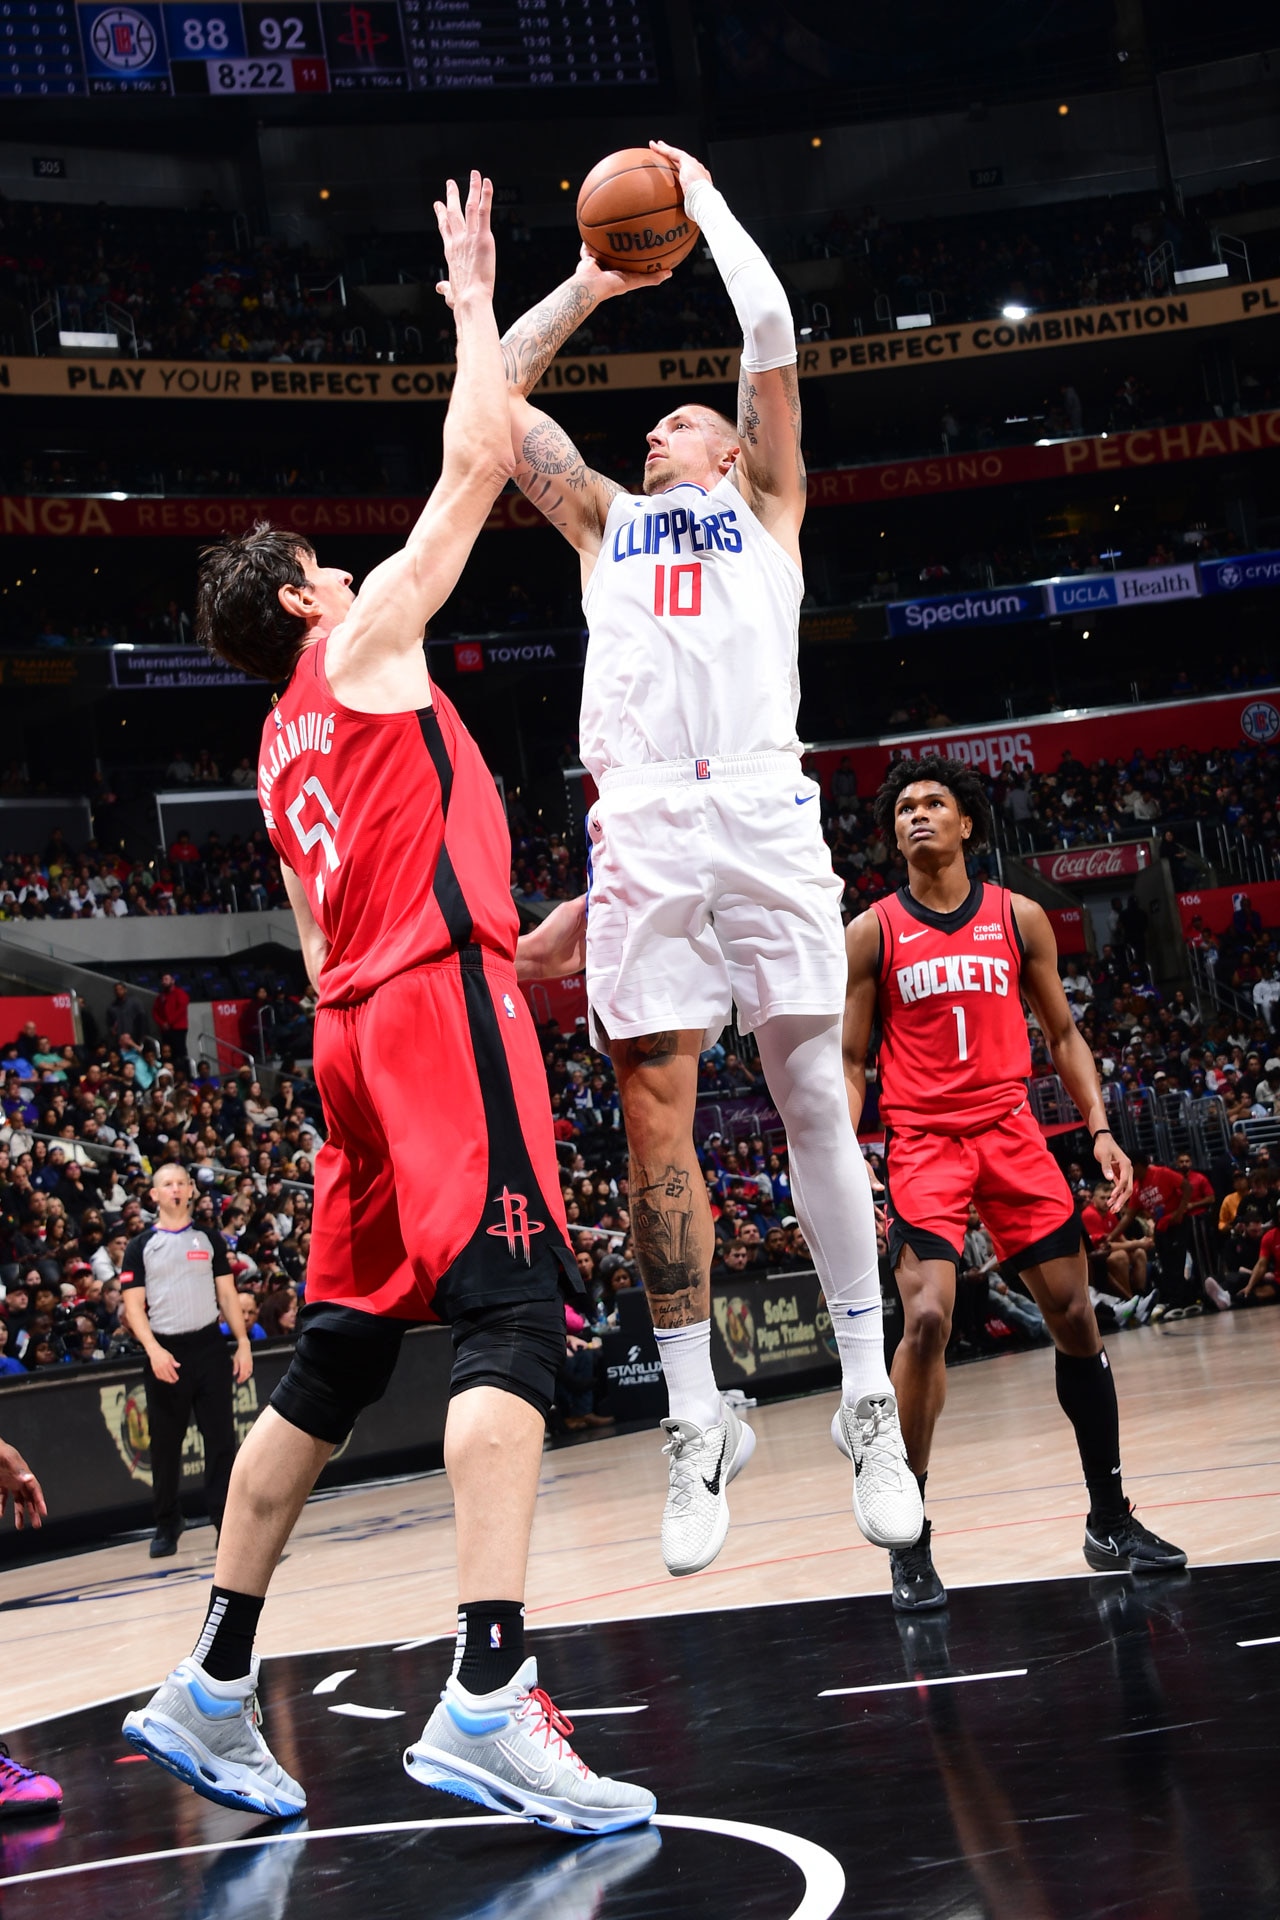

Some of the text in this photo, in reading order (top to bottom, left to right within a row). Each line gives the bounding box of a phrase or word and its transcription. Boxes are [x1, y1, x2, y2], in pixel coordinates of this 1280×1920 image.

[182, 18, 229, 51] 88
[259, 17, 306, 50] 92
[218, 63, 285, 89] 8:22
[301, 69, 318, 82] 11
[40, 160, 60, 174] 305
[606, 222, 689, 252] Wilson
[830, 332, 961, 367] PERFECT
[973, 302, 1188, 350] COMBINATION
[67, 366, 145, 390] PLAY
[159, 368, 240, 392] YOUR
[252, 371, 380, 395] PERFECT
[660, 355, 730, 380] PLAY
[880, 455, 1003, 492] CASINO
[137, 504, 270, 529] RESORT
[291, 504, 409, 529] CASINO
[613, 507, 743, 563] CLIPPERS
[654, 562, 702, 616] 10
[1062, 574, 1190, 605] UCLA Health
[904, 595, 1021, 630] Spectrum
[128, 656, 212, 670] International
[487, 643, 556, 663] TOYOTA
[1052, 847, 1123, 880] Coca-Cola
[1180, 894, 1200, 906] 106
[974, 923, 1001, 932] credit
[1060, 911, 1080, 922] 105
[973, 932, 1003, 941] karma
[561, 978, 581, 989] 104
[896, 955, 1009, 1005] ROCKETS
[217, 1003, 237, 1016] 104
[952, 1006, 968, 1061] 1
[665, 1182, 685, 1198] 27
[763, 1295, 799, 1325] SoCal
[780, 1320, 816, 1344] Trades
